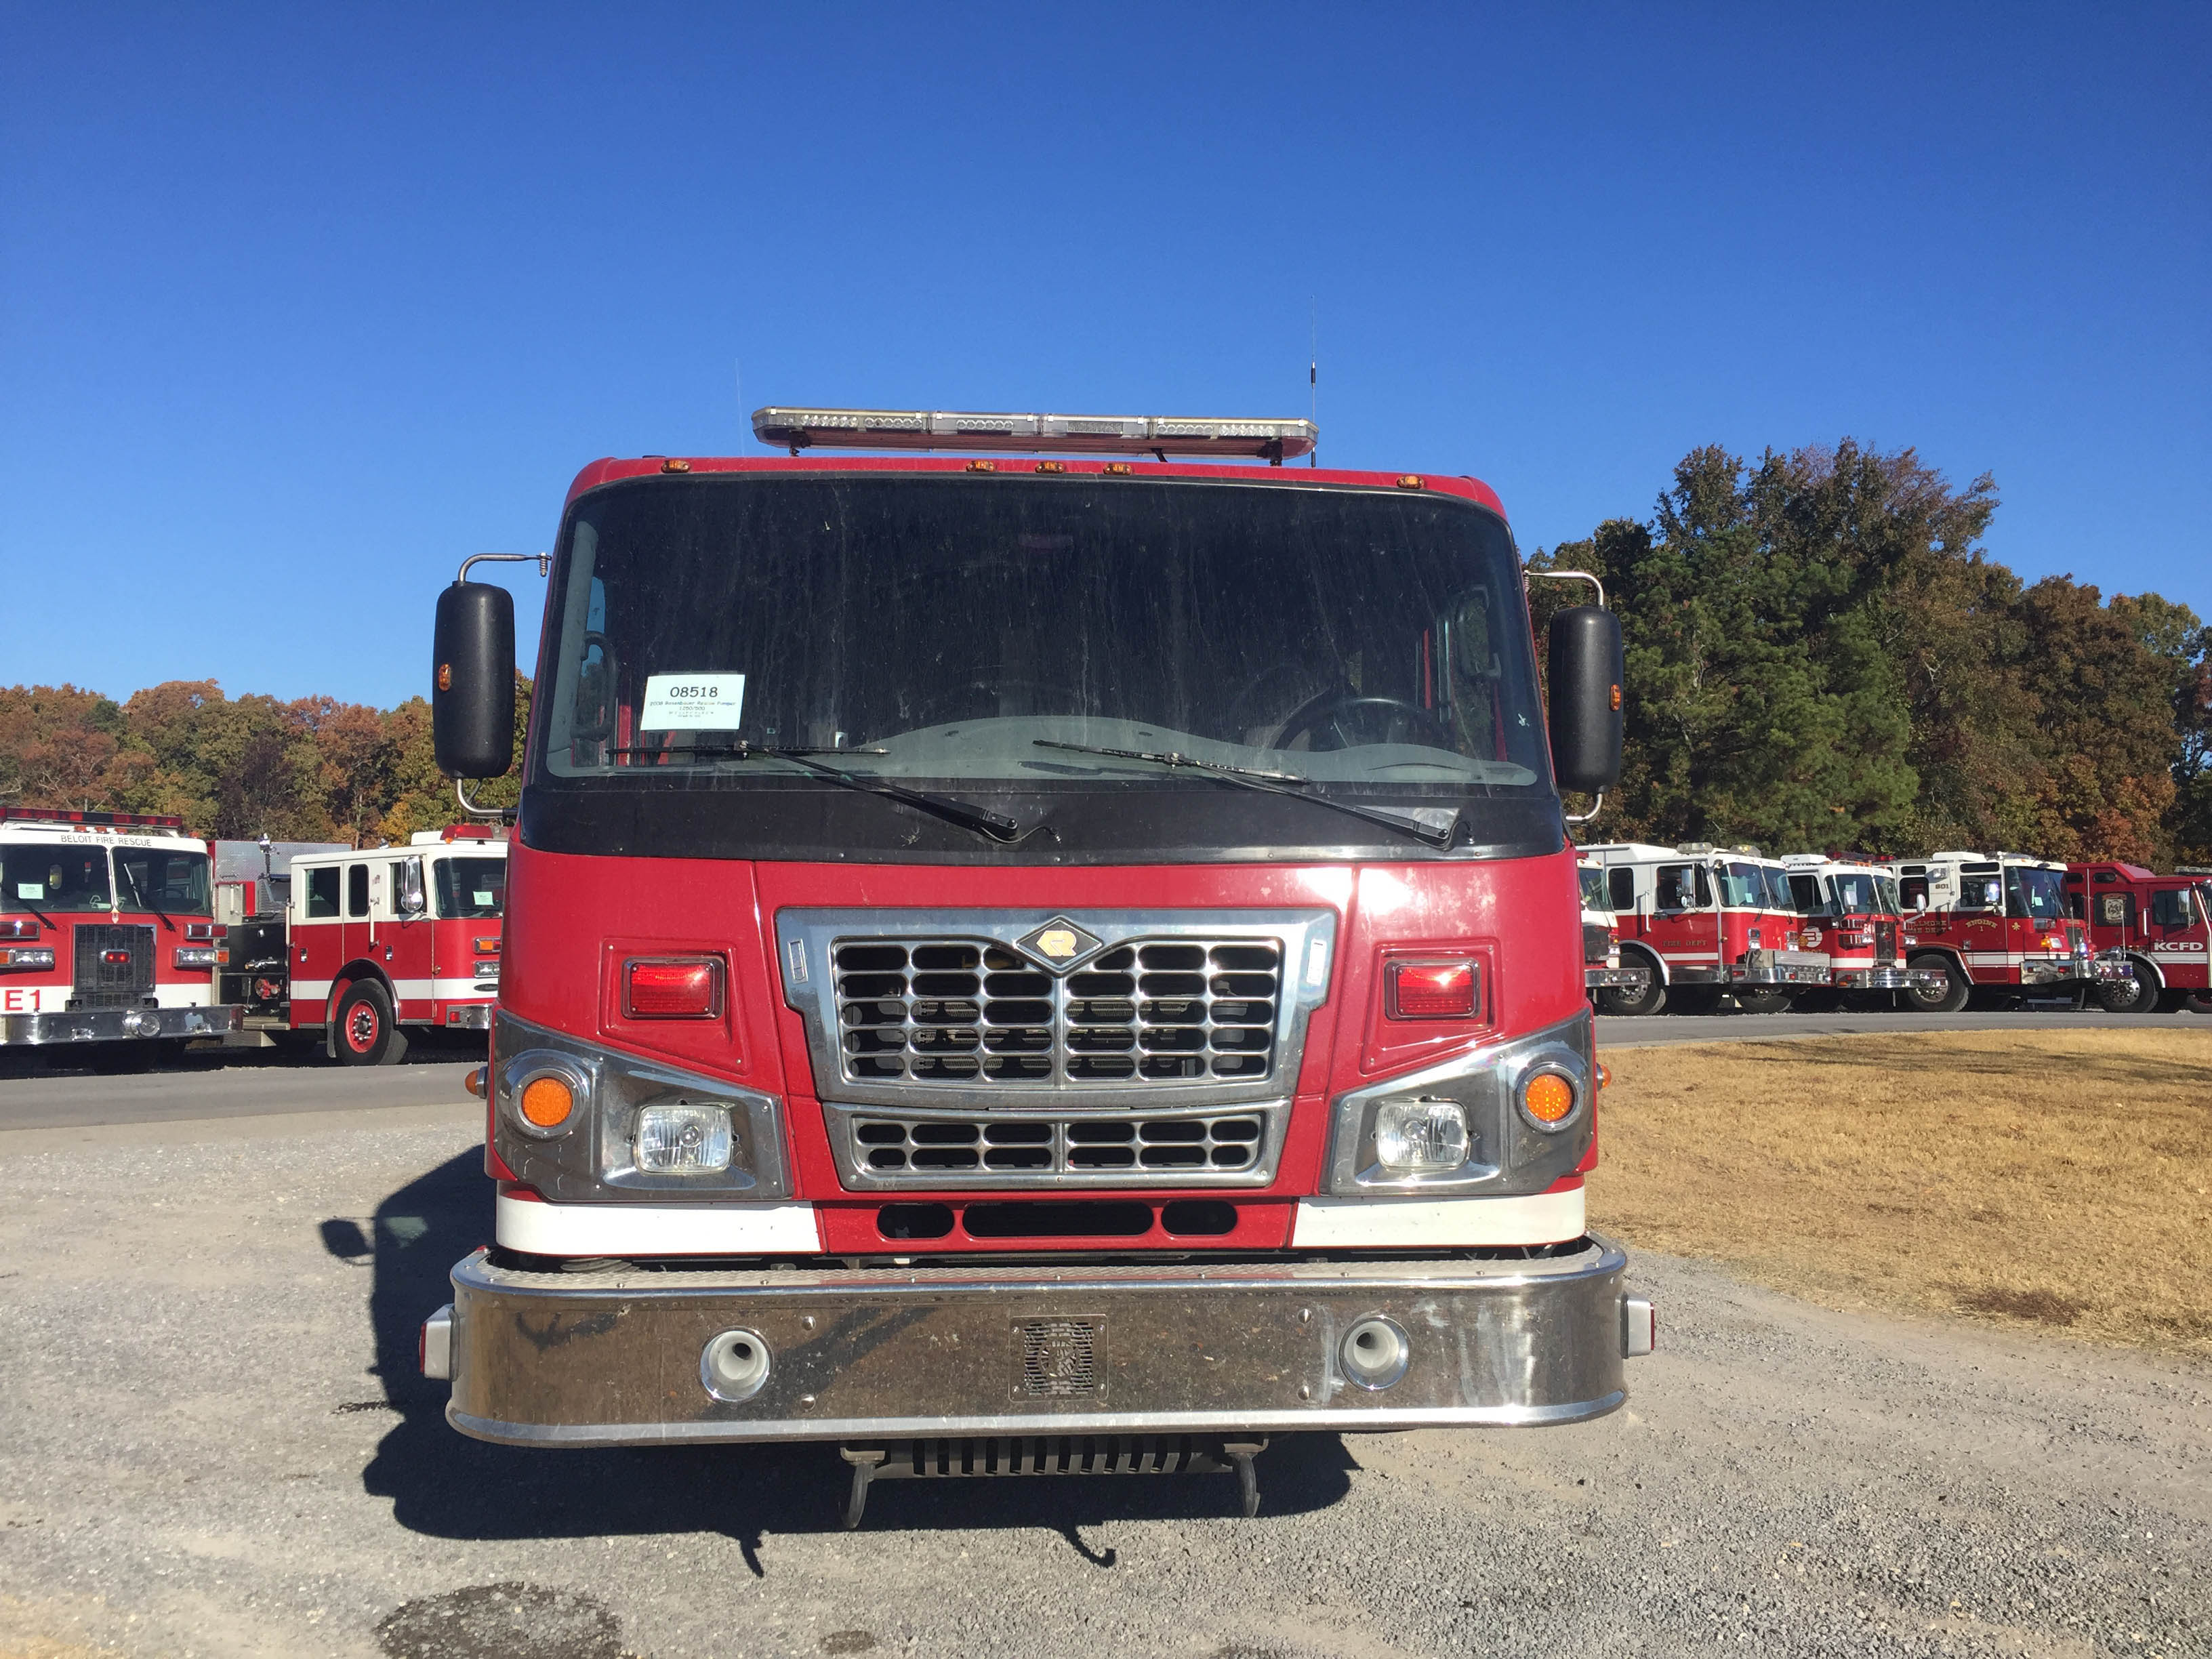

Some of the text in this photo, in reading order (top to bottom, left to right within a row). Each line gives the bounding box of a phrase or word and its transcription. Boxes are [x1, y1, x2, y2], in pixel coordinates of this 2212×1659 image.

[670, 686, 718, 698] 08518
[61, 835, 152, 846] BELOIT FIRE RESCUE
[2154, 942, 2204, 951] KCFD
[5, 989, 41, 1010] E1
